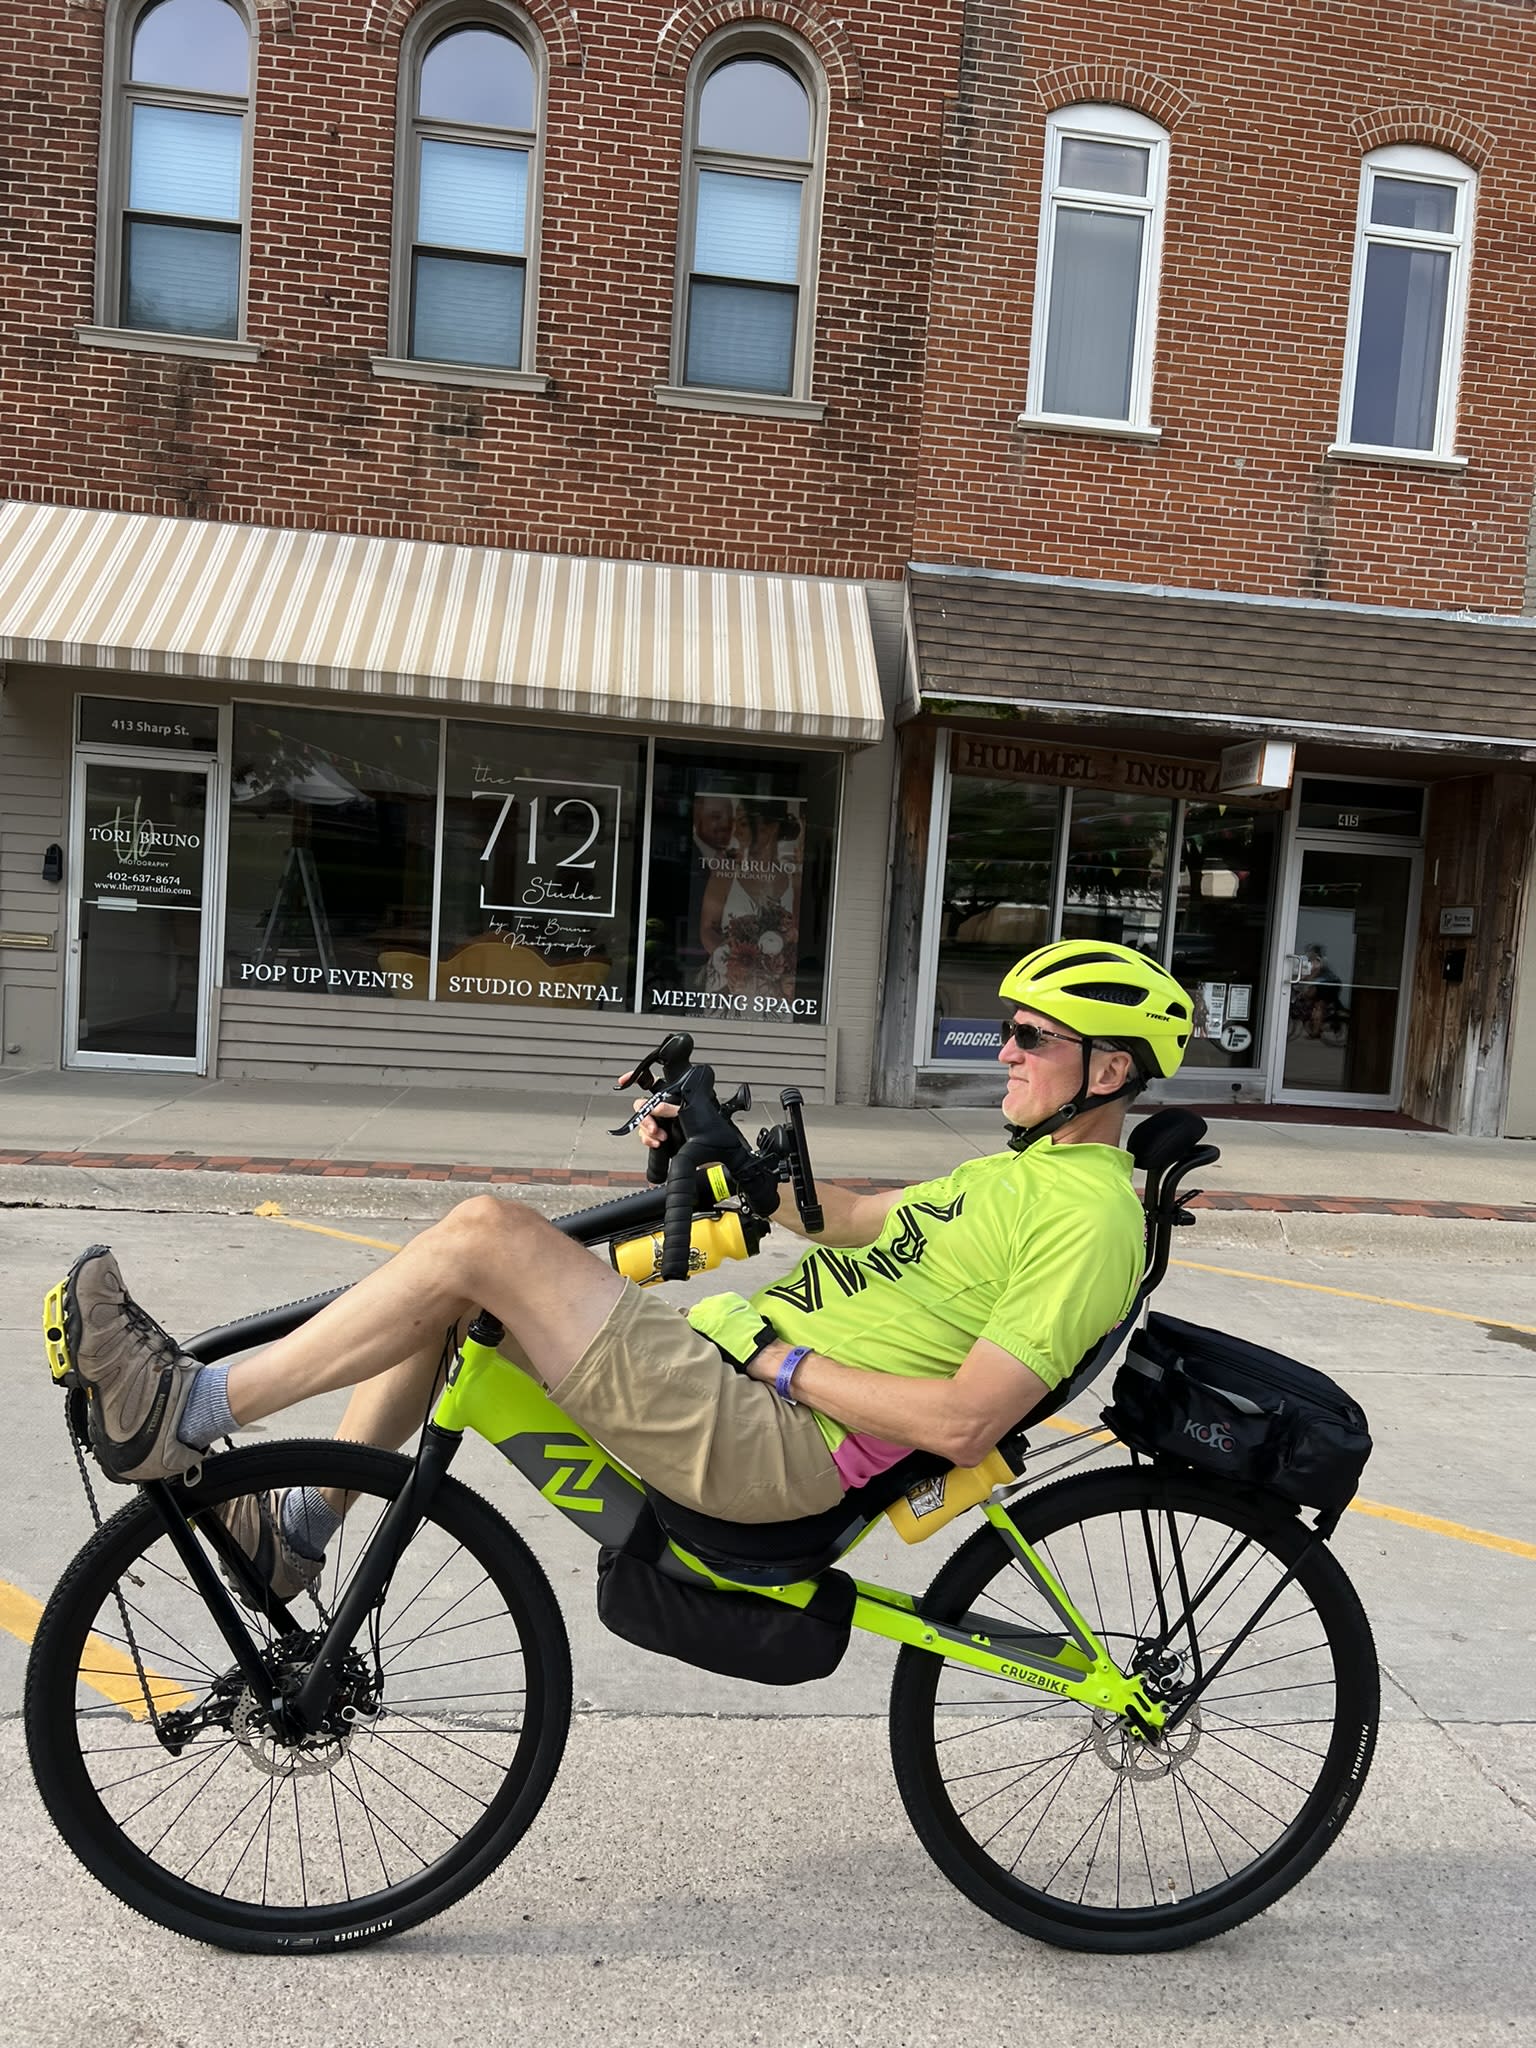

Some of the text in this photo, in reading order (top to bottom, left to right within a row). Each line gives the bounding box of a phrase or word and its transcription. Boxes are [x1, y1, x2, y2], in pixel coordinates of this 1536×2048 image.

[111, 719, 190, 736] 413 Sharp St.
[966, 742, 1098, 780] HUMMEL
[471, 763, 512, 784] the
[471, 790, 601, 870] 712
[1338, 814, 1359, 827] 415
[89, 827, 200, 848] TORI BRUNO
[119, 859, 170, 868] PHOTOGRAPHY
[698, 856, 797, 874] TORI BRUNO
[94, 881, 192, 896] www.the712studio.com
[106, 871, 181, 886] 402-637-8674
[521, 876, 603, 905] Studio
[503, 932, 597, 957] Photography
[240, 963, 414, 991] POP UP EVENTS
[449, 976, 624, 1004] STUDIO RENTAL
[651, 989, 818, 1016] MEETING SPACE
[1145, 1012, 1170, 1022] TREK
[1350, 1723, 1370, 1781] PATHFINDER
[333, 1919, 394, 1942] PATHFINDER
